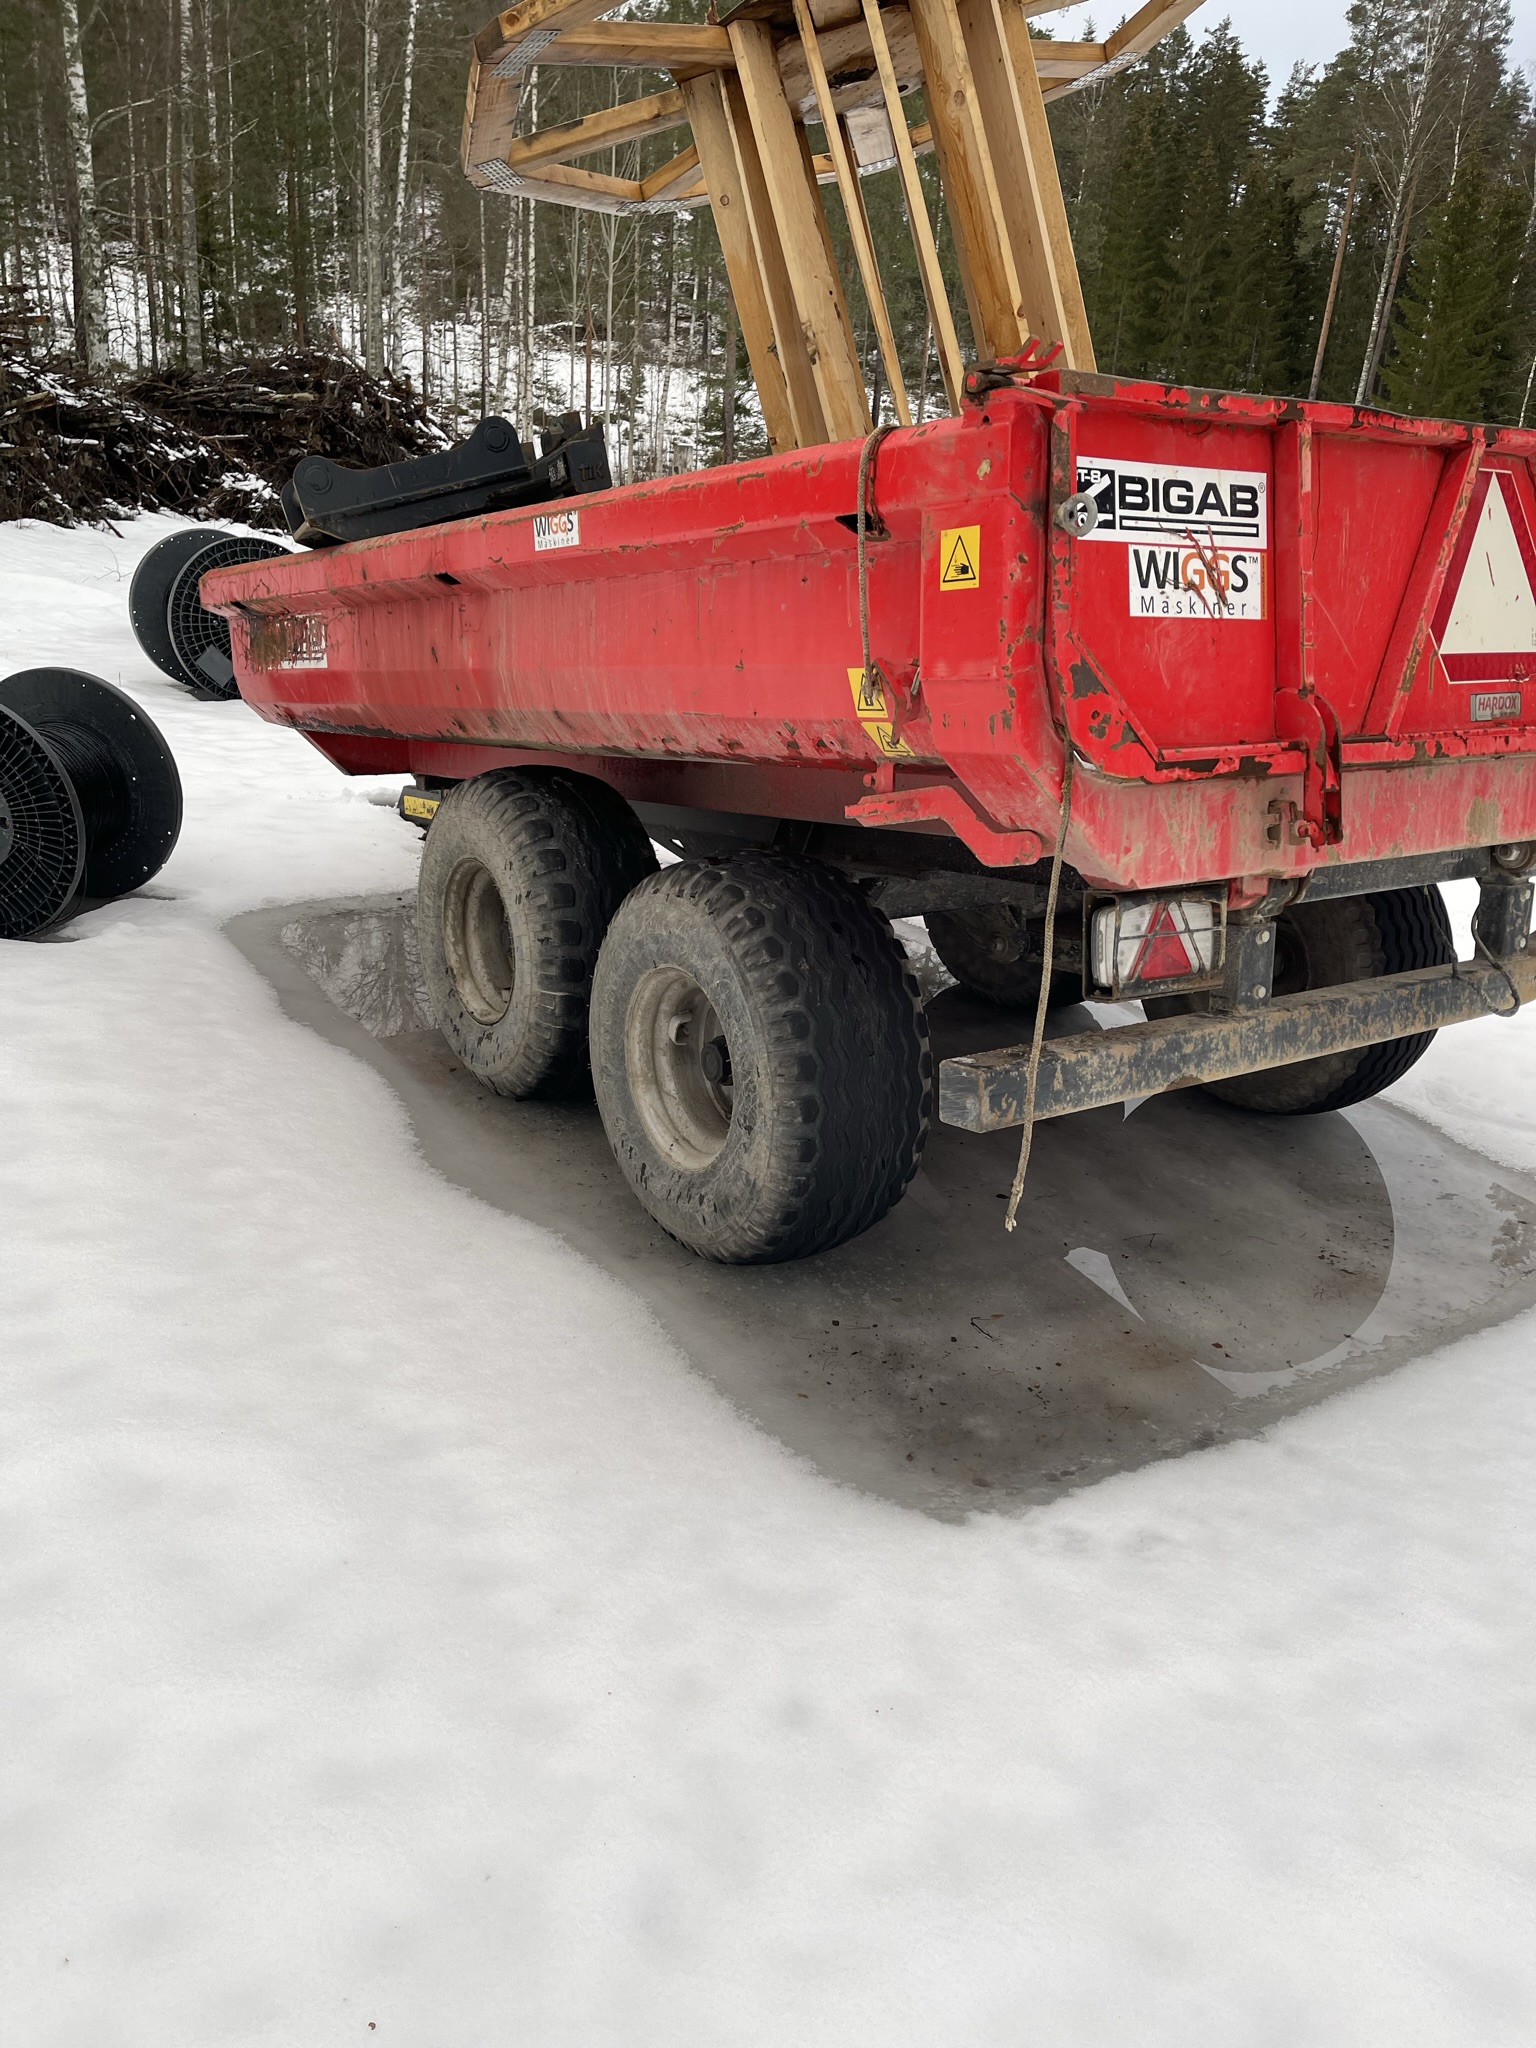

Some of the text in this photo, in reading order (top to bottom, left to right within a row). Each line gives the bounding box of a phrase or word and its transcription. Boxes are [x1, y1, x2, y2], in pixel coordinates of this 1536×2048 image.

[1077, 469, 1101, 484] T-8
[1118, 474, 1259, 519] BIGAB
[534, 512, 574, 537] WIGGS
[537, 536, 574, 549] Maskiner
[1133, 549, 1249, 593] WIGGS
[1140, 596, 1247, 616] Maskiner
[1478, 695, 1517, 712] HARDOX
